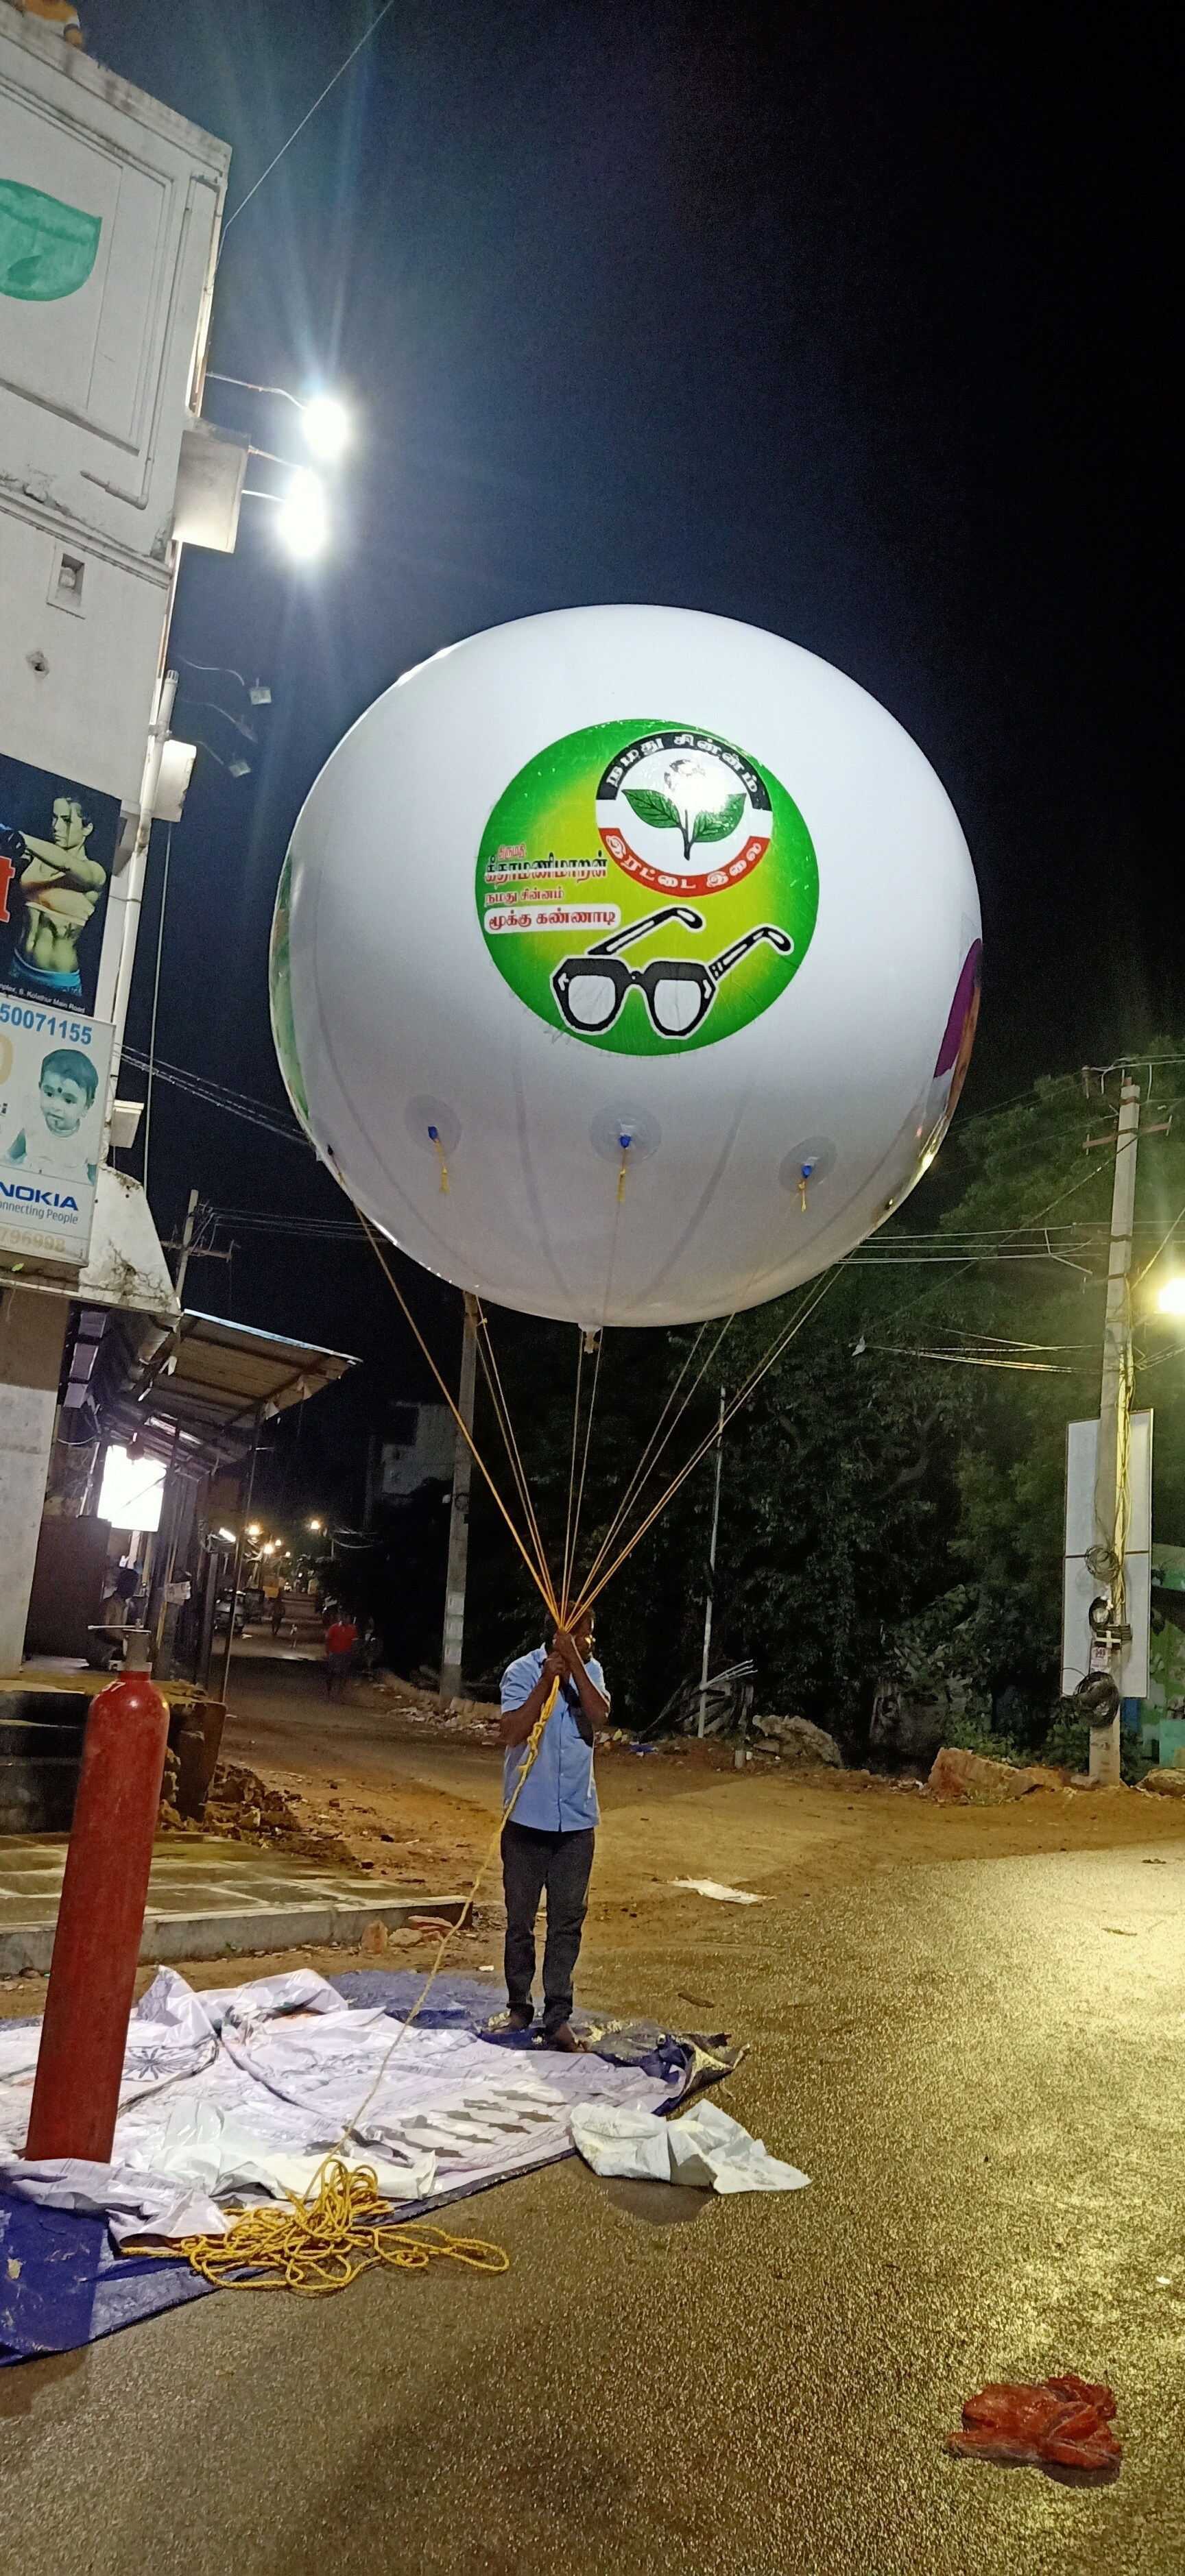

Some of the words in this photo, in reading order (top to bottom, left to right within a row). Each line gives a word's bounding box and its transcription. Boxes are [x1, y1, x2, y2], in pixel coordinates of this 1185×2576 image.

[606, 738, 665, 787] நமது
[606, 834, 696, 889] இரட்டை
[706, 843, 762, 887] இலை
[486, 892, 518, 904] நமது
[521, 886, 564, 900] சின்னம்
[489, 909, 532, 930] மூக்கு
[536, 907, 616, 926] கண்ணாடி
[53, 998, 68, 1009] Main
[69, 1003, 86, 1013] Road
[0, 1181, 79, 1212] NOKIA
[46, 1208, 79, 1225] People
